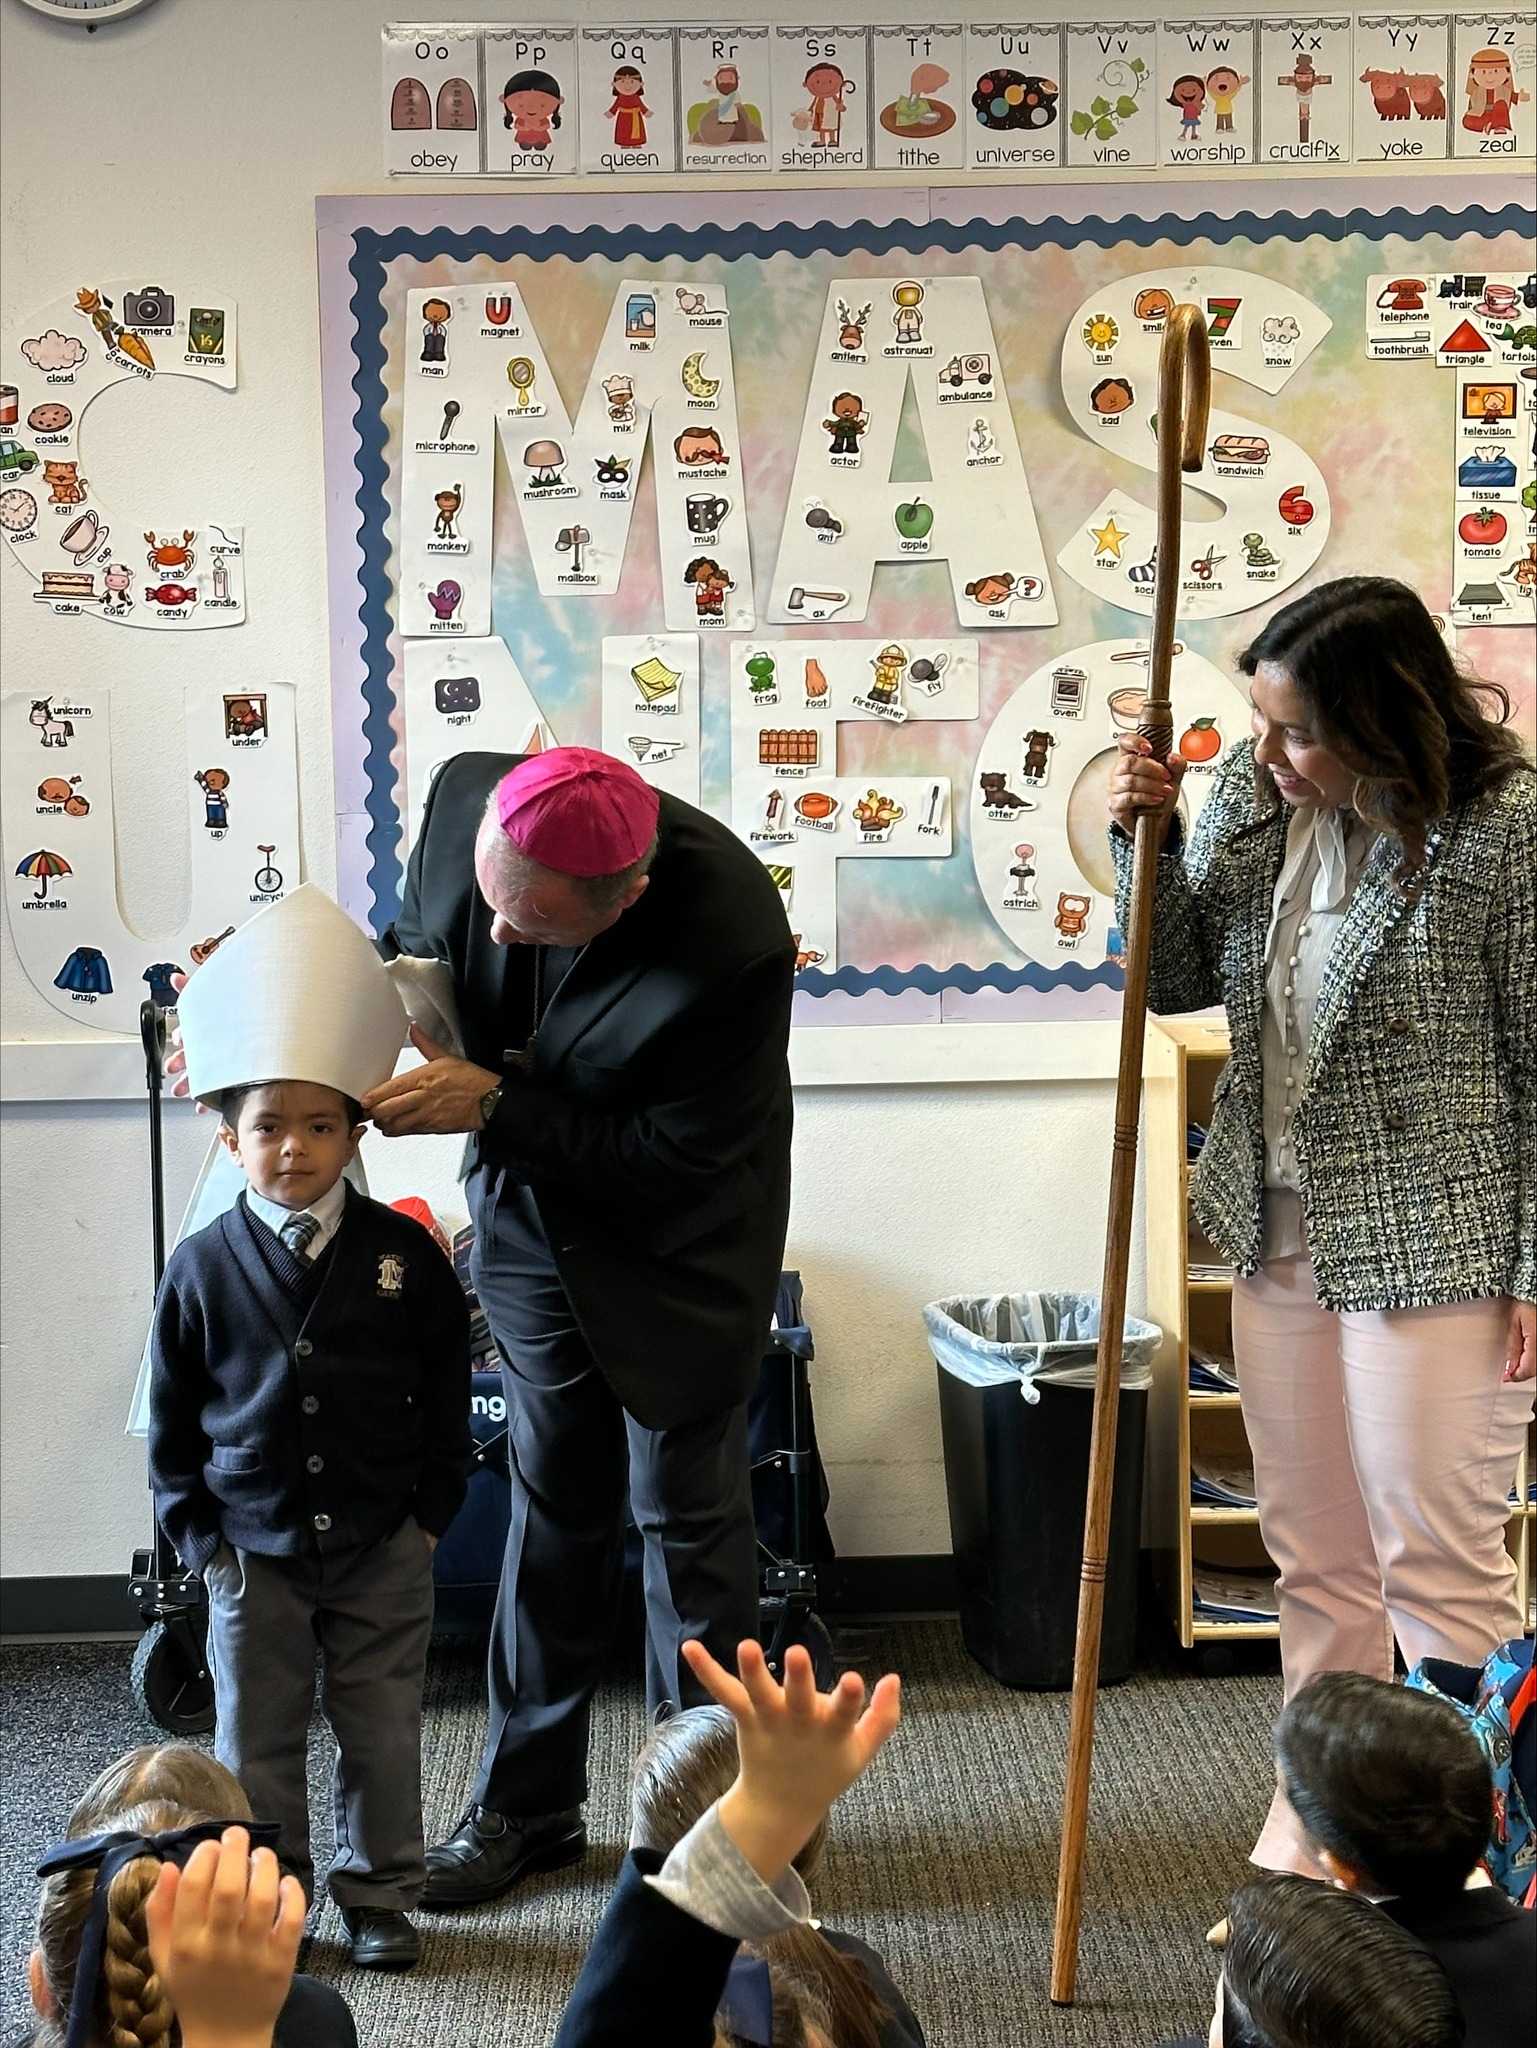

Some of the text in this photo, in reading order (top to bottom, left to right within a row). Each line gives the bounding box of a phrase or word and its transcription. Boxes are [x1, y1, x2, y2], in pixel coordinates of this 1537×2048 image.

[1269, 141, 1340, 159] crucifix
[1380, 139, 1423, 158] yoke
[1479, 137, 1518, 154] zeal
[686, 152, 767, 165] resurrection
[781, 148, 863, 169] shepherd
[897, 149, 940, 165] tithe
[975, 146, 1055, 163] universe
[1094, 146, 1130, 162] vine
[1170, 144, 1245, 164] worship
[410, 151, 458, 171] obey
[510, 152, 555, 171] pray
[600, 152, 659, 170] queen
[689, 318, 723, 327] mouse
[1379, 312, 1430, 322] telephone
[1485, 320, 1502, 330] tea
[481, 327, 520, 338] magnet
[201, 334, 213, 346] 16
[1209, 338, 1233, 347] even
[629, 341, 651, 351] milk
[1374, 344, 1429, 355] toothbrush
[184, 355, 225, 366] crayons
[830, 351, 867, 363] antlers
[1095, 354, 1113, 363] sun
[1265, 357, 1292, 366] snow
[1445, 354, 1485, 365] triangle
[1501, 351, 1536, 362] tortois
[115, 356, 152, 379] carrots
[421, 366, 444, 376] man
[46, 373, 74, 383] cloud
[939, 390, 993, 402] ambulance
[687, 400, 716, 408] moon
[507, 405, 542, 416] mirror
[1101, 416, 1120, 425] sad
[613, 423, 632, 433] mix
[1463, 426, 1512, 436] television
[35, 434, 69, 444] cookie
[415, 442, 476, 452] microphone
[830, 456, 859, 467] actor
[966, 455, 1001, 467] anchor
[2, 470, 20, 480] car
[678, 468, 727, 479] mustache
[1216, 465, 1264, 477] sandwich
[523, 486, 577, 499] mushroom
[600, 490, 627, 499] mask
[1471, 490, 1501, 500] tissue
[55, 505, 72, 514] cat
[1287, 526, 1302, 536] six
[10, 530, 37, 544] clock
[694, 534, 716, 545] mug
[817, 533, 834, 543] ant
[210, 546, 241, 554] curve
[427, 541, 468, 551] monkey
[900, 539, 928, 550] apple
[97, 547, 112, 563] cup
[1463, 547, 1501, 557] tomato
[1096, 557, 1118, 568] star
[160, 569, 185, 578] crab
[557, 573, 597, 583] mailbox
[1246, 569, 1276, 578] snake
[1182, 581, 1223, 590] scissors
[55, 603, 80, 612] cake
[204, 599, 237, 607] candle
[103, 606, 125, 615] cow
[156, 608, 188, 619] candy
[812, 609, 826, 618] ax
[988, 608, 1006, 619] ask
[699, 618, 725, 626] mom
[1471, 612, 1492, 621] tent
[430, 621, 463, 631] mitten
[927, 680, 942, 693] fly
[753, 694, 778, 704] frog
[805, 698, 827, 708] foot
[53, 705, 92, 716] unicorn
[634, 702, 677, 714] notepad
[851, 696, 905, 720] firefighter
[1053, 708, 1078, 719] oven
[446, 714, 472, 726] night
[231, 737, 262, 747] under
[651, 749, 668, 760] net
[775, 766, 804, 776] fence
[1026, 777, 1038, 786] ox
[35, 803, 63, 814] uncle
[988, 808, 1014, 820] otter
[794, 816, 833, 830] football
[210, 829, 223, 839] up
[917, 823, 940, 835] fork
[750, 831, 795, 841] firework
[863, 832, 883, 842] fire
[249, 891, 284, 903] unicycl
[22, 898, 67, 909] umbrella
[1002, 897, 1039, 910] ostrich
[1056, 937, 1075, 949] owl
[71, 991, 97, 1003] unzip
[472, 1394, 507, 1423] ng
